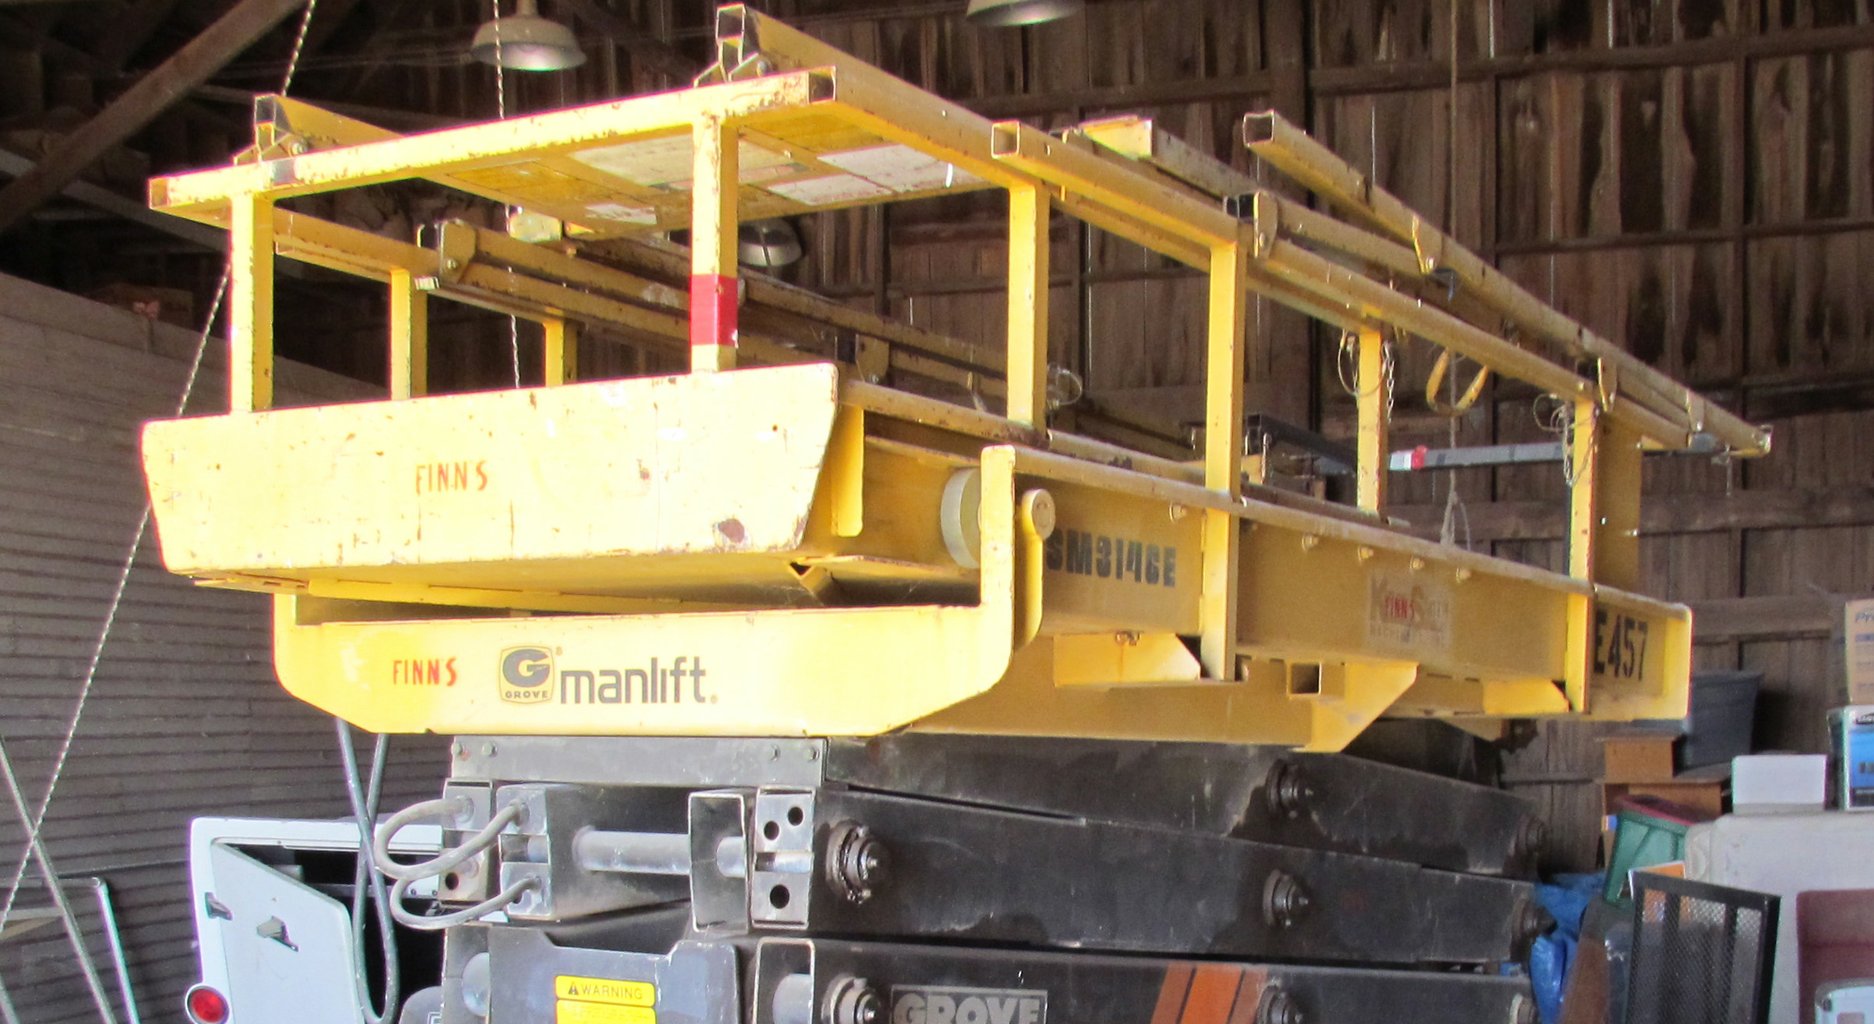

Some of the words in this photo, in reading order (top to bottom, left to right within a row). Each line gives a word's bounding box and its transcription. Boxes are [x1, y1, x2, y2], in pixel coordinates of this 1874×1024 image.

[1593, 607, 1648, 681] E457
[505, 690, 549, 699] GROVE
[581, 983, 644, 1000] WARNING
